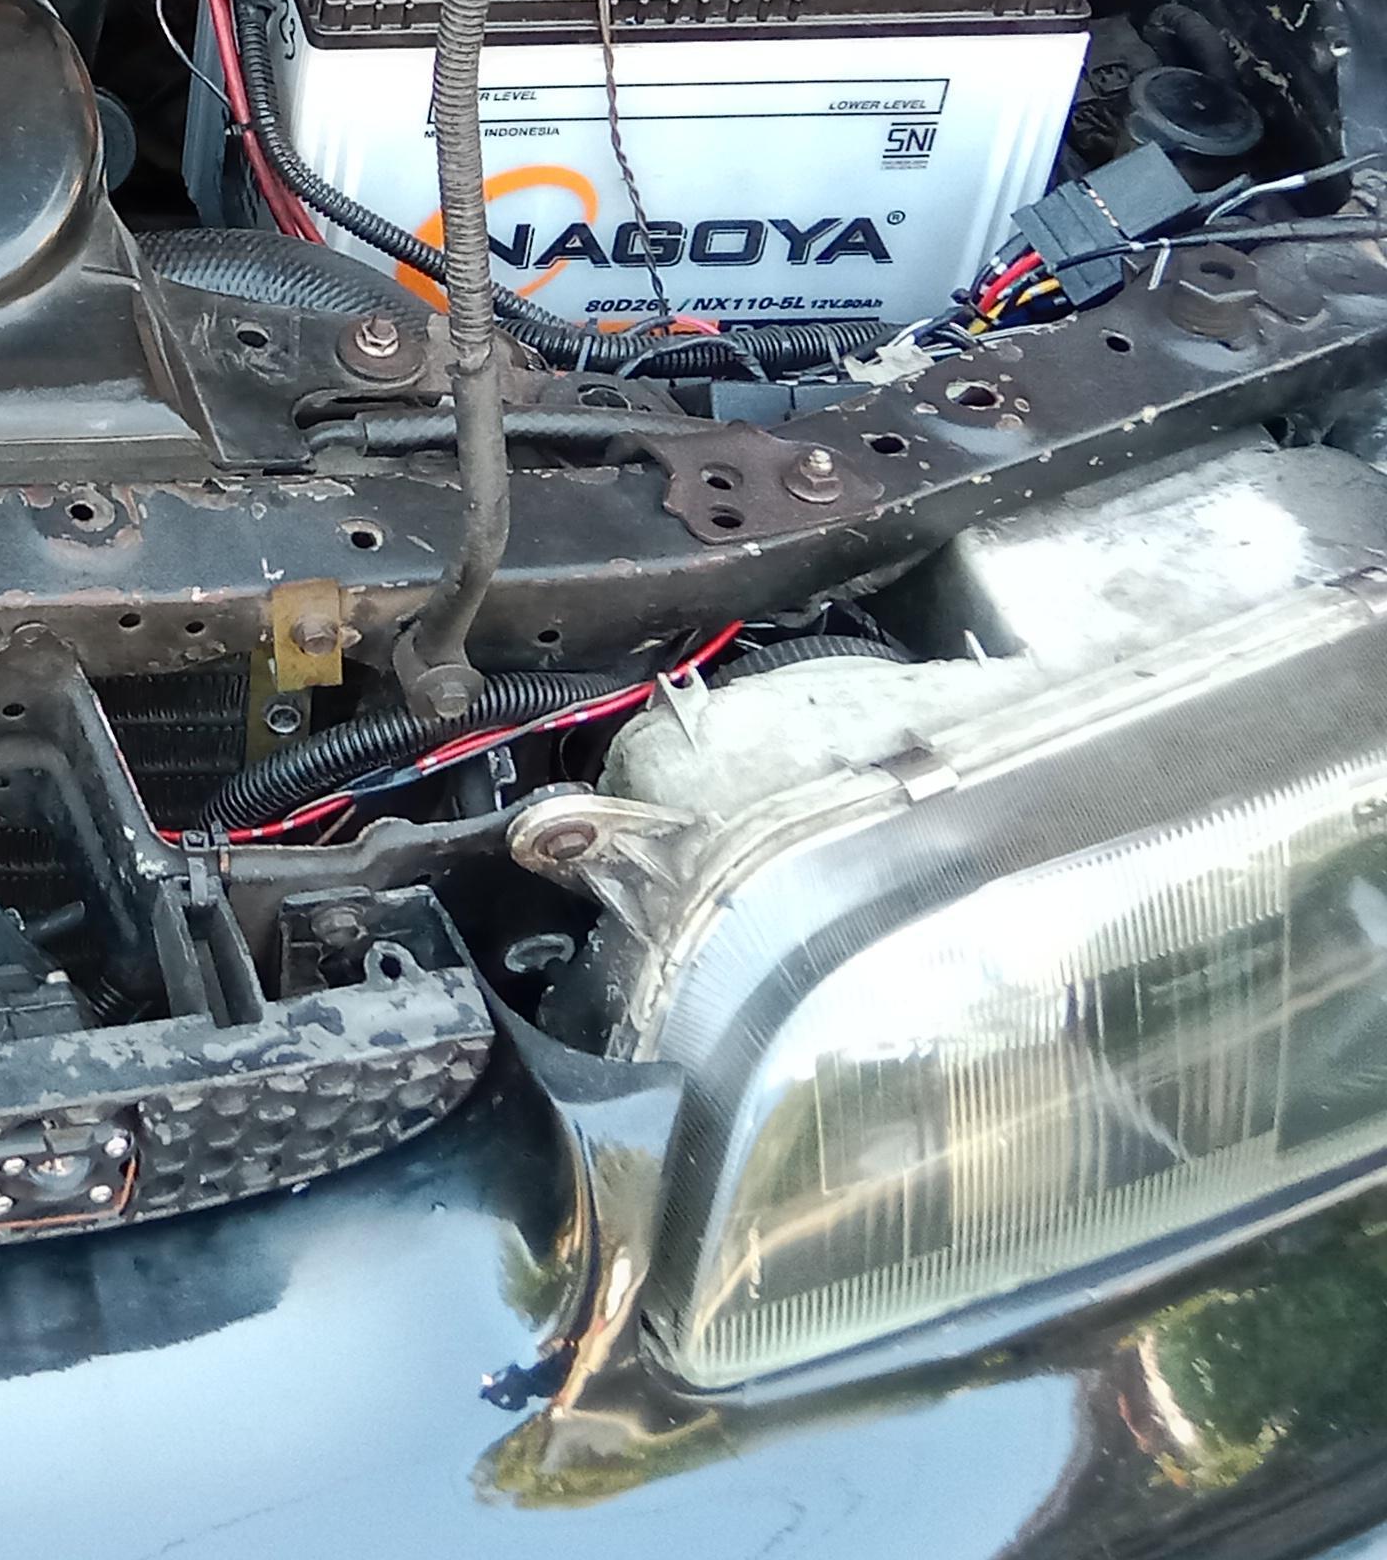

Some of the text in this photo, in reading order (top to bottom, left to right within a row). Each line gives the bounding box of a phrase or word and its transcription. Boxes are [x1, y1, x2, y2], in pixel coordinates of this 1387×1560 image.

[493, 90, 537, 101] LEVEL
[828, 99, 927, 110] LOWER LEVEL
[484, 126, 560, 138] INDONESIA
[884, 127, 937, 152] SNI
[488, 217, 894, 269] NAGOYA
[691, 296, 805, 311] NX110-5L
